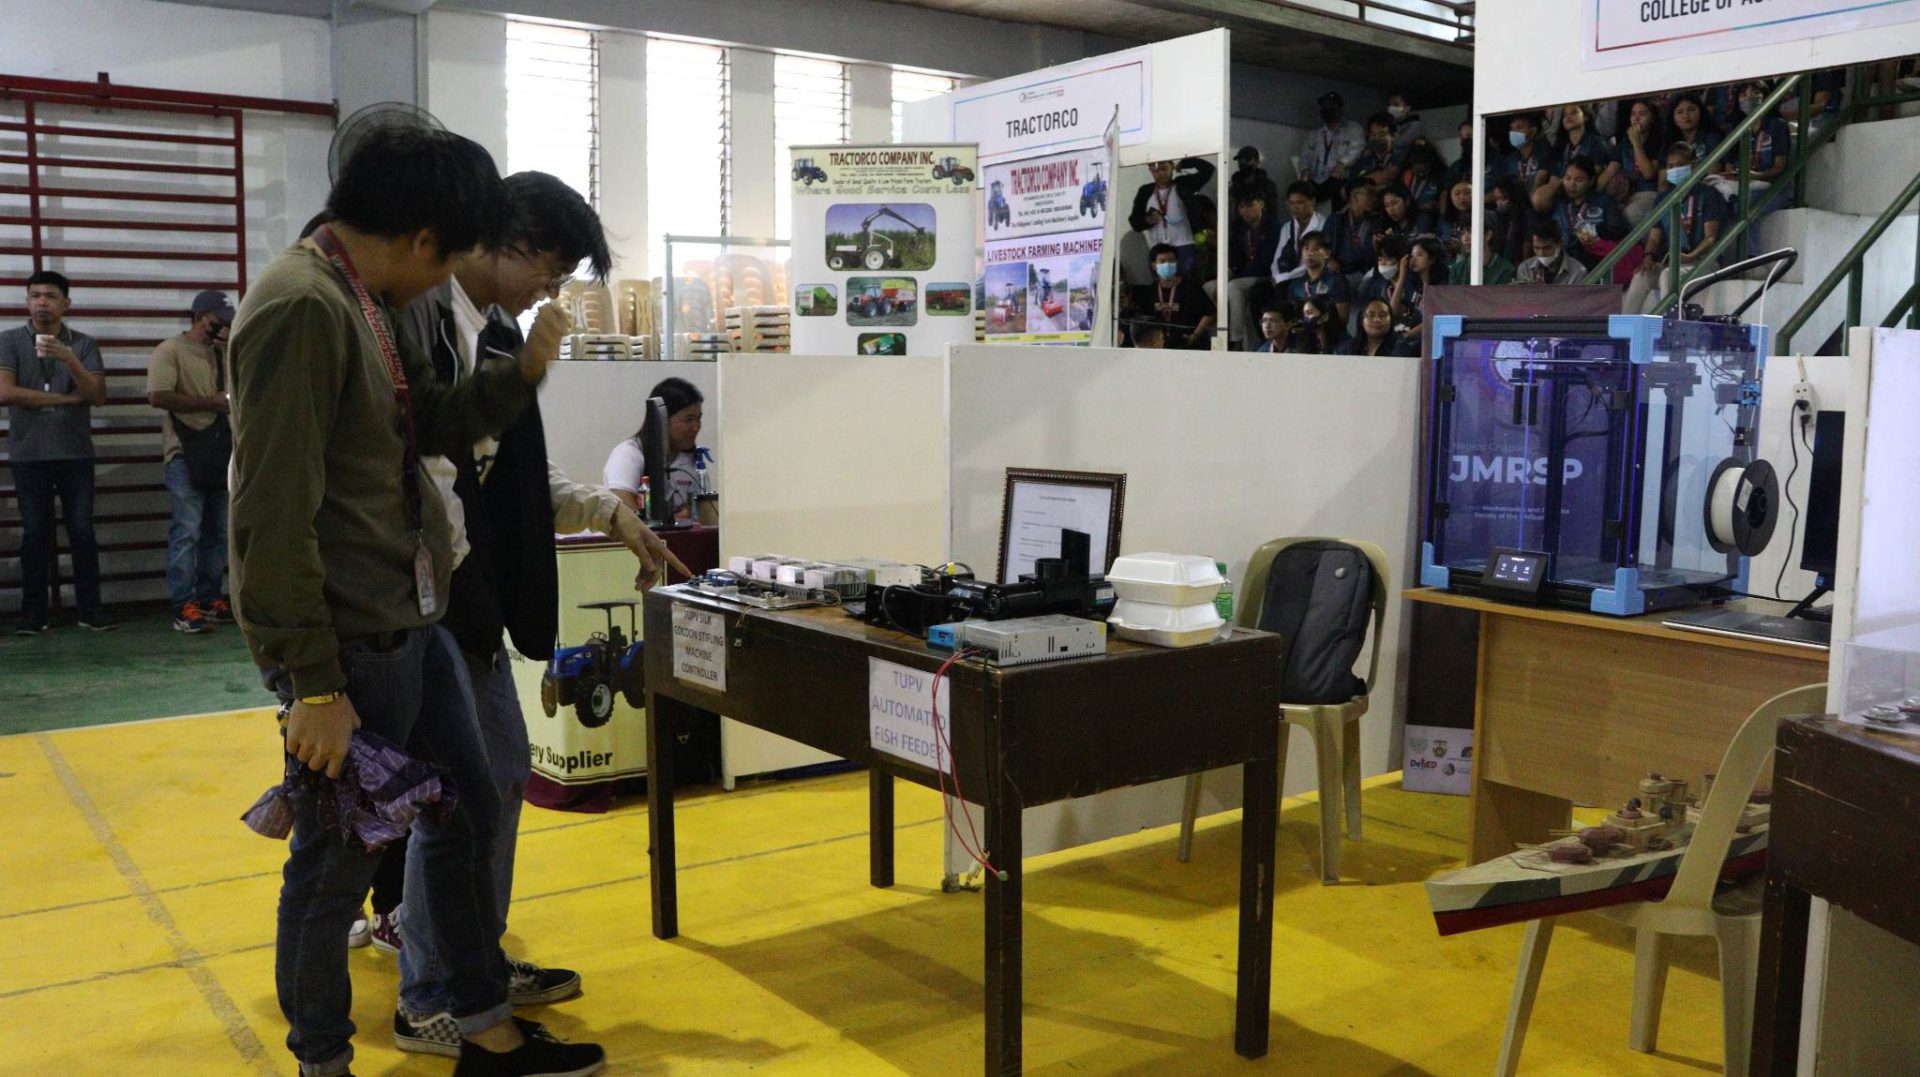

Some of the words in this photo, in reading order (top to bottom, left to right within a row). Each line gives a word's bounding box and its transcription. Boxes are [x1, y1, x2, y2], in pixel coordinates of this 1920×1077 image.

[1640, 0, 1710, 22] COLLEGE
[1006, 108, 1078, 138] TRACTORCO
[829, 152, 878, 166] TRACTORCO
[879, 152, 919, 166] COMPANY
[920, 151, 935, 165] INC.
[987, 247, 1026, 262] LIVESTOCK
[1028, 243, 1060, 259] FARMING
[1063, 238, 1103, 256] MACHINER
[1449, 454, 1583, 486] JMRSP
[674, 625, 697, 639] COCOON
[685, 646, 712, 662] MACHINE
[681, 662, 718, 681] CONTROLLER
[892, 670, 923, 693] TUPV
[874, 726, 898, 747] FISH
[546, 746, 613, 774] Supplier
